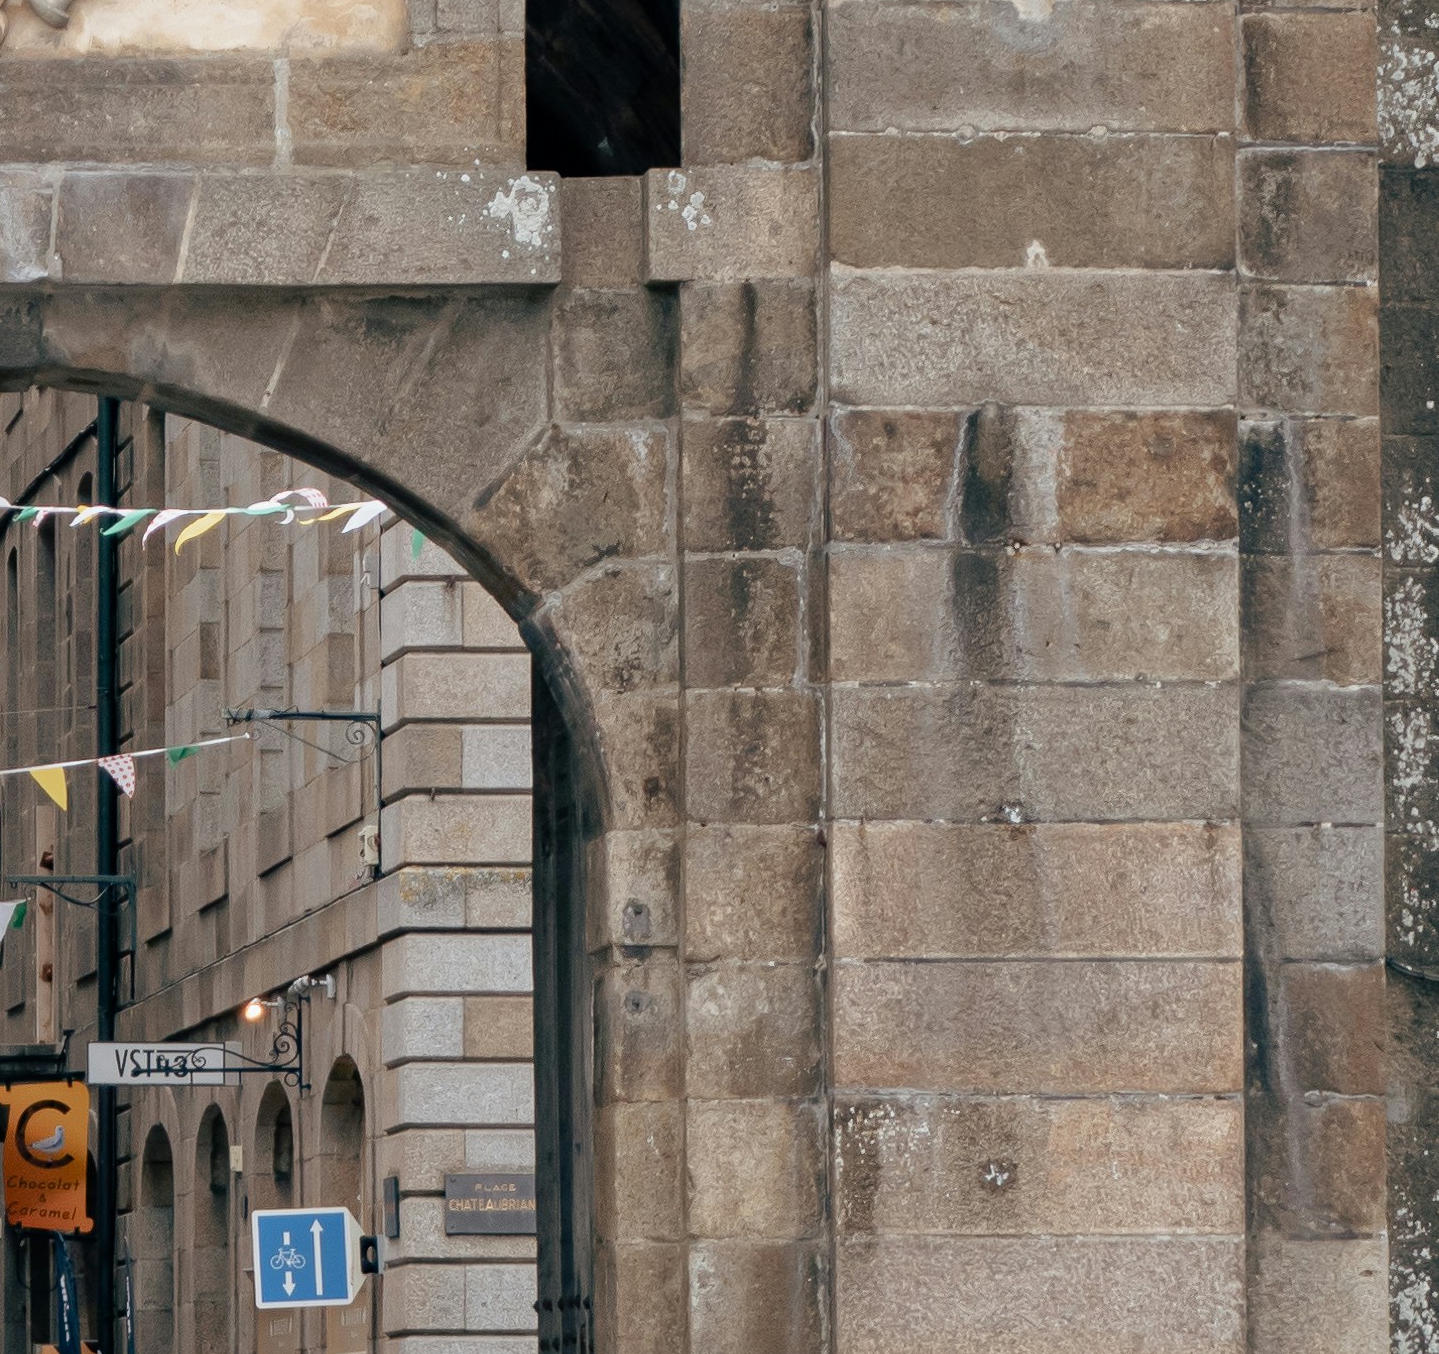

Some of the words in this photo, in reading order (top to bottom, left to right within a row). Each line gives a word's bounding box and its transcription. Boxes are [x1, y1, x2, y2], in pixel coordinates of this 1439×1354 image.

[6, 1175, 81, 1191] Chocolat
[474, 1182, 517, 1192] PLACE
[6, 1201, 77, 1221] Caramel
[448, 1198, 536, 1212] CHATEAUBRIAN
